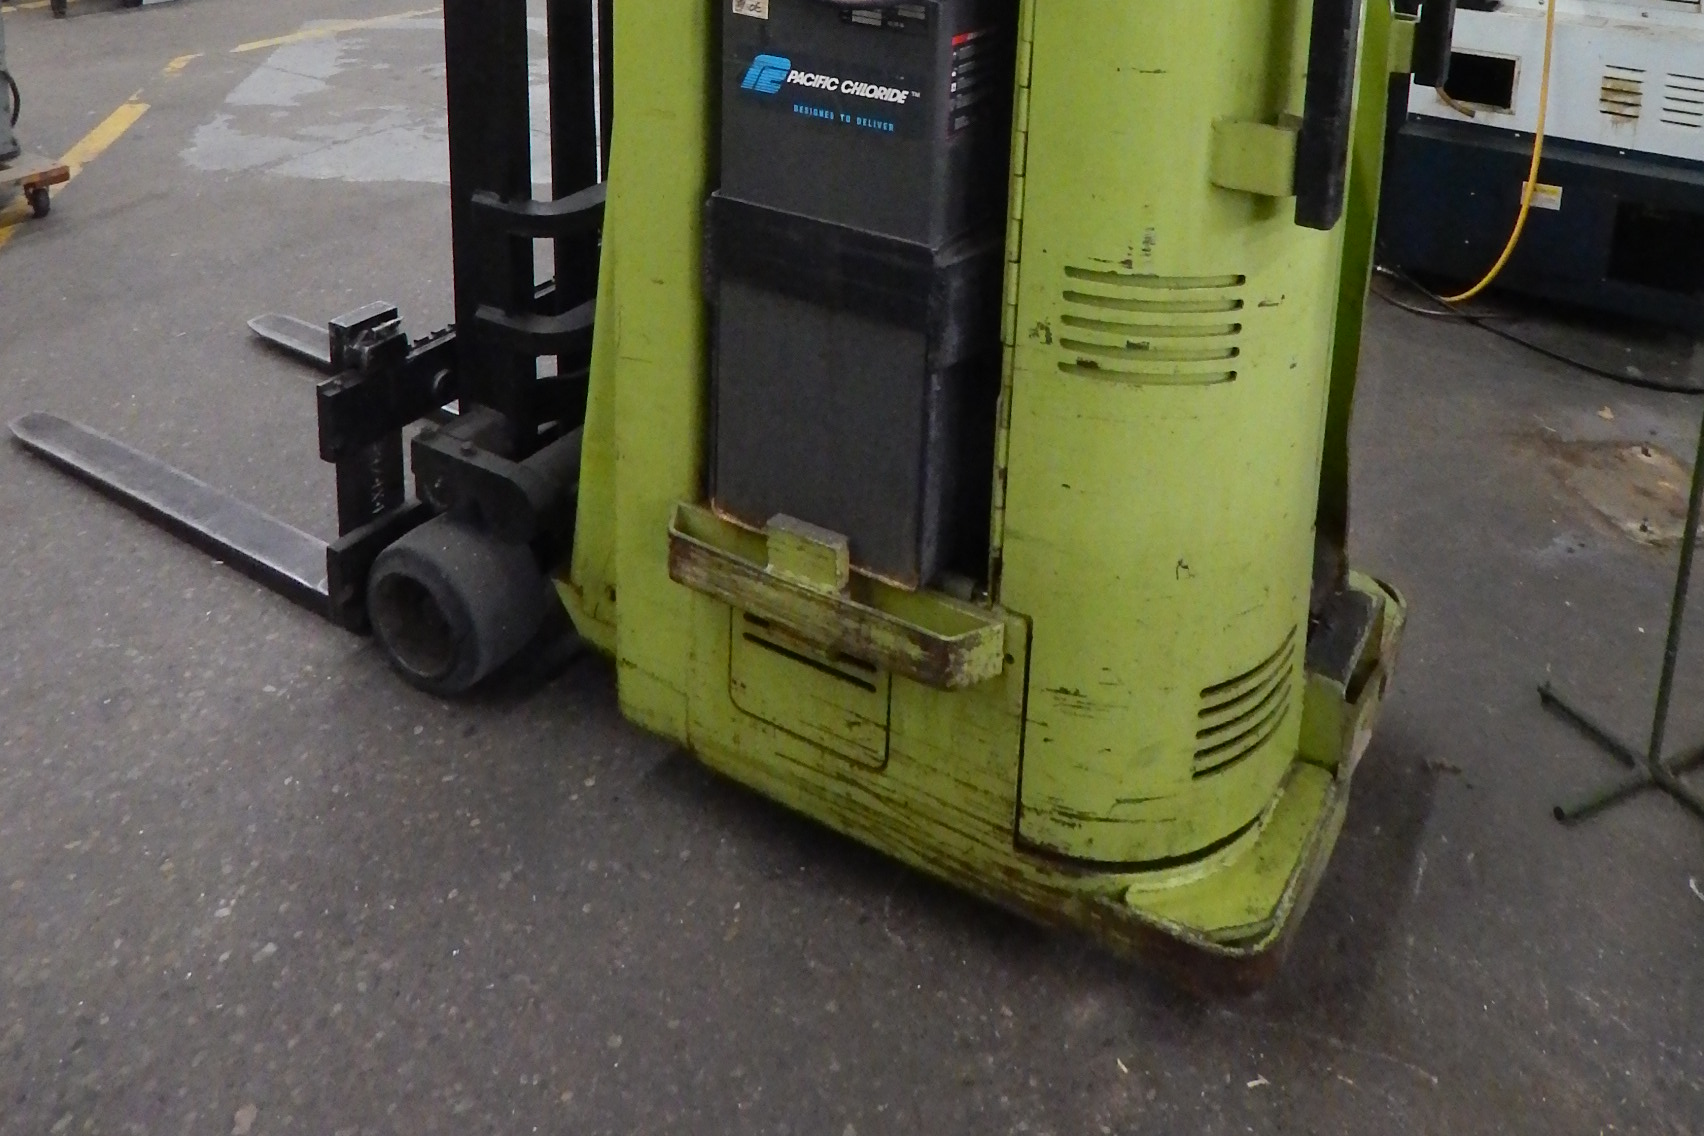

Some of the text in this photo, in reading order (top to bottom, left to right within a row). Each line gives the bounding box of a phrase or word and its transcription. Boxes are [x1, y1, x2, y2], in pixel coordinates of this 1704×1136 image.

[787, 69, 839, 91] PACIFIC
[841, 80, 909, 104] CHLORIDE
[793, 104, 895, 132] DESIGNED TO DELIVER
